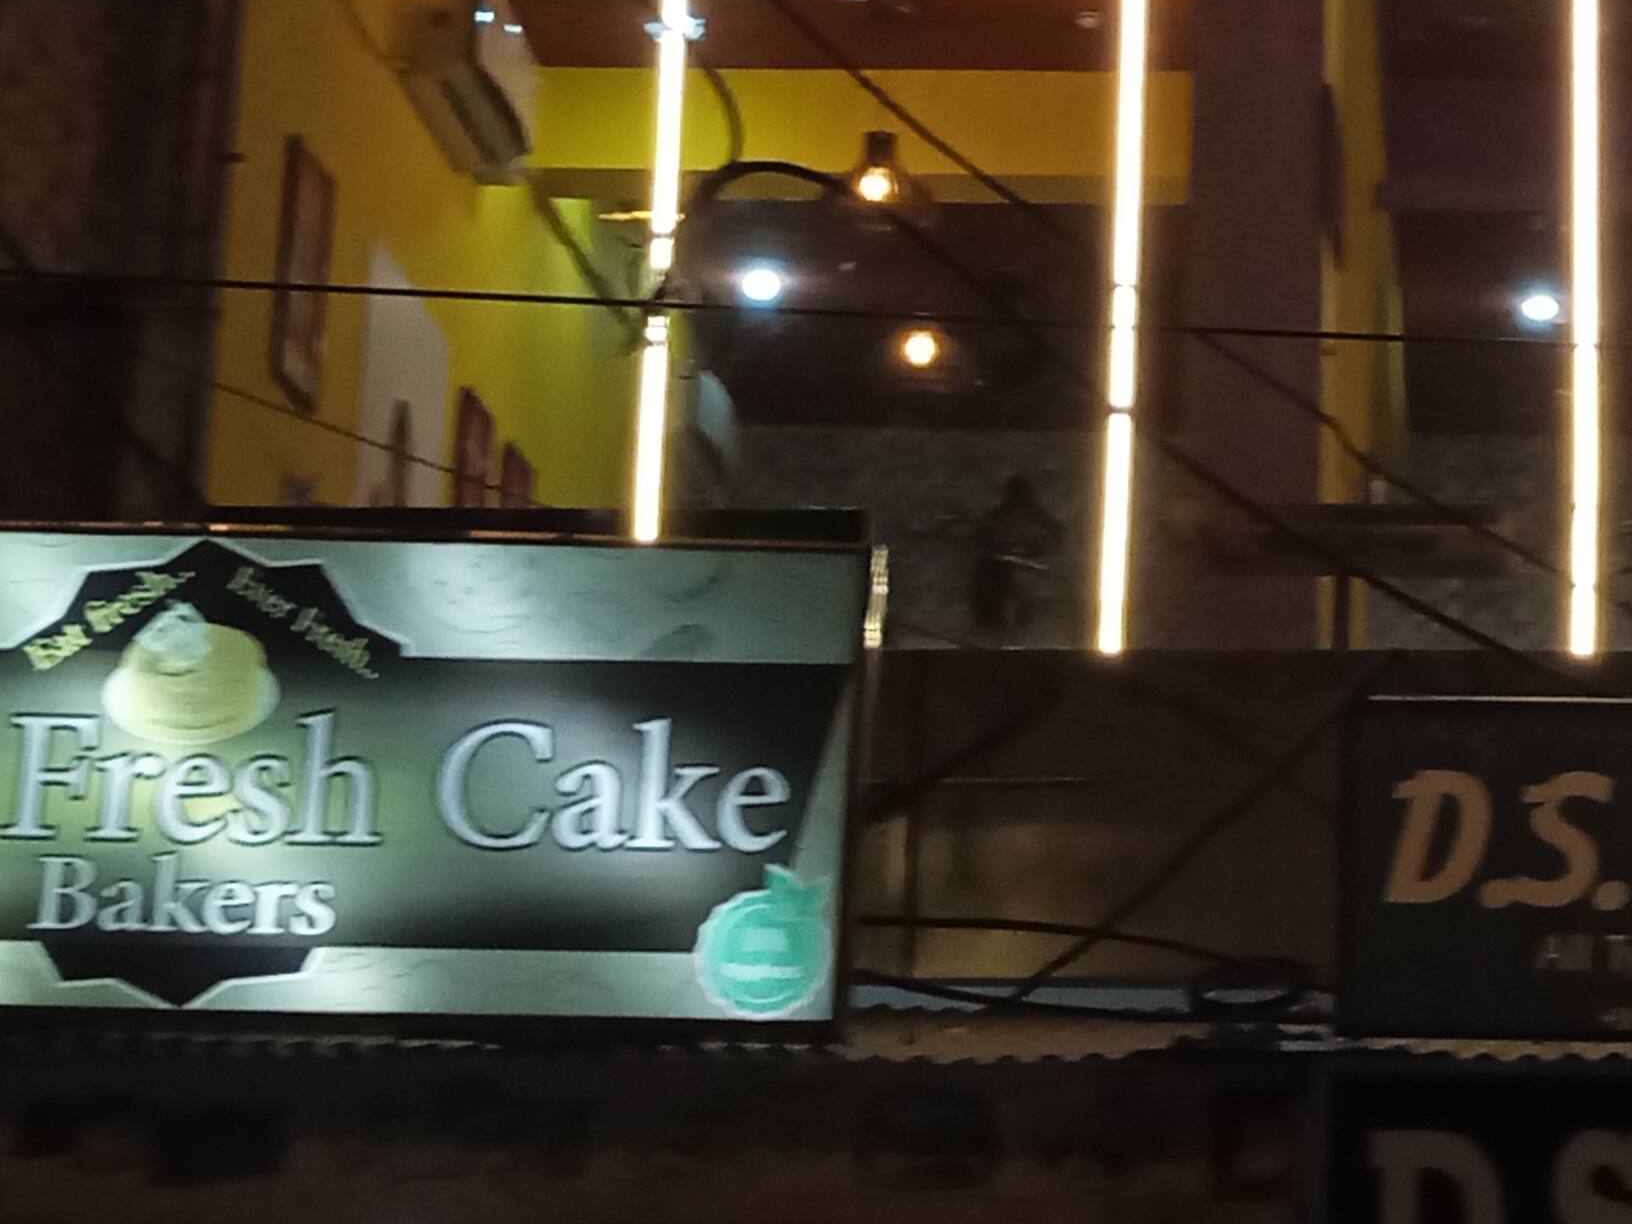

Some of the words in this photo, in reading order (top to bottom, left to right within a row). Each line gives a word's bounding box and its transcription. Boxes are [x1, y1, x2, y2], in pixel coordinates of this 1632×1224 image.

[0, 709, 383, 846] Fresh
[437, 717, 791, 853] Cake
[27, 852, 336, 937] Bakers
